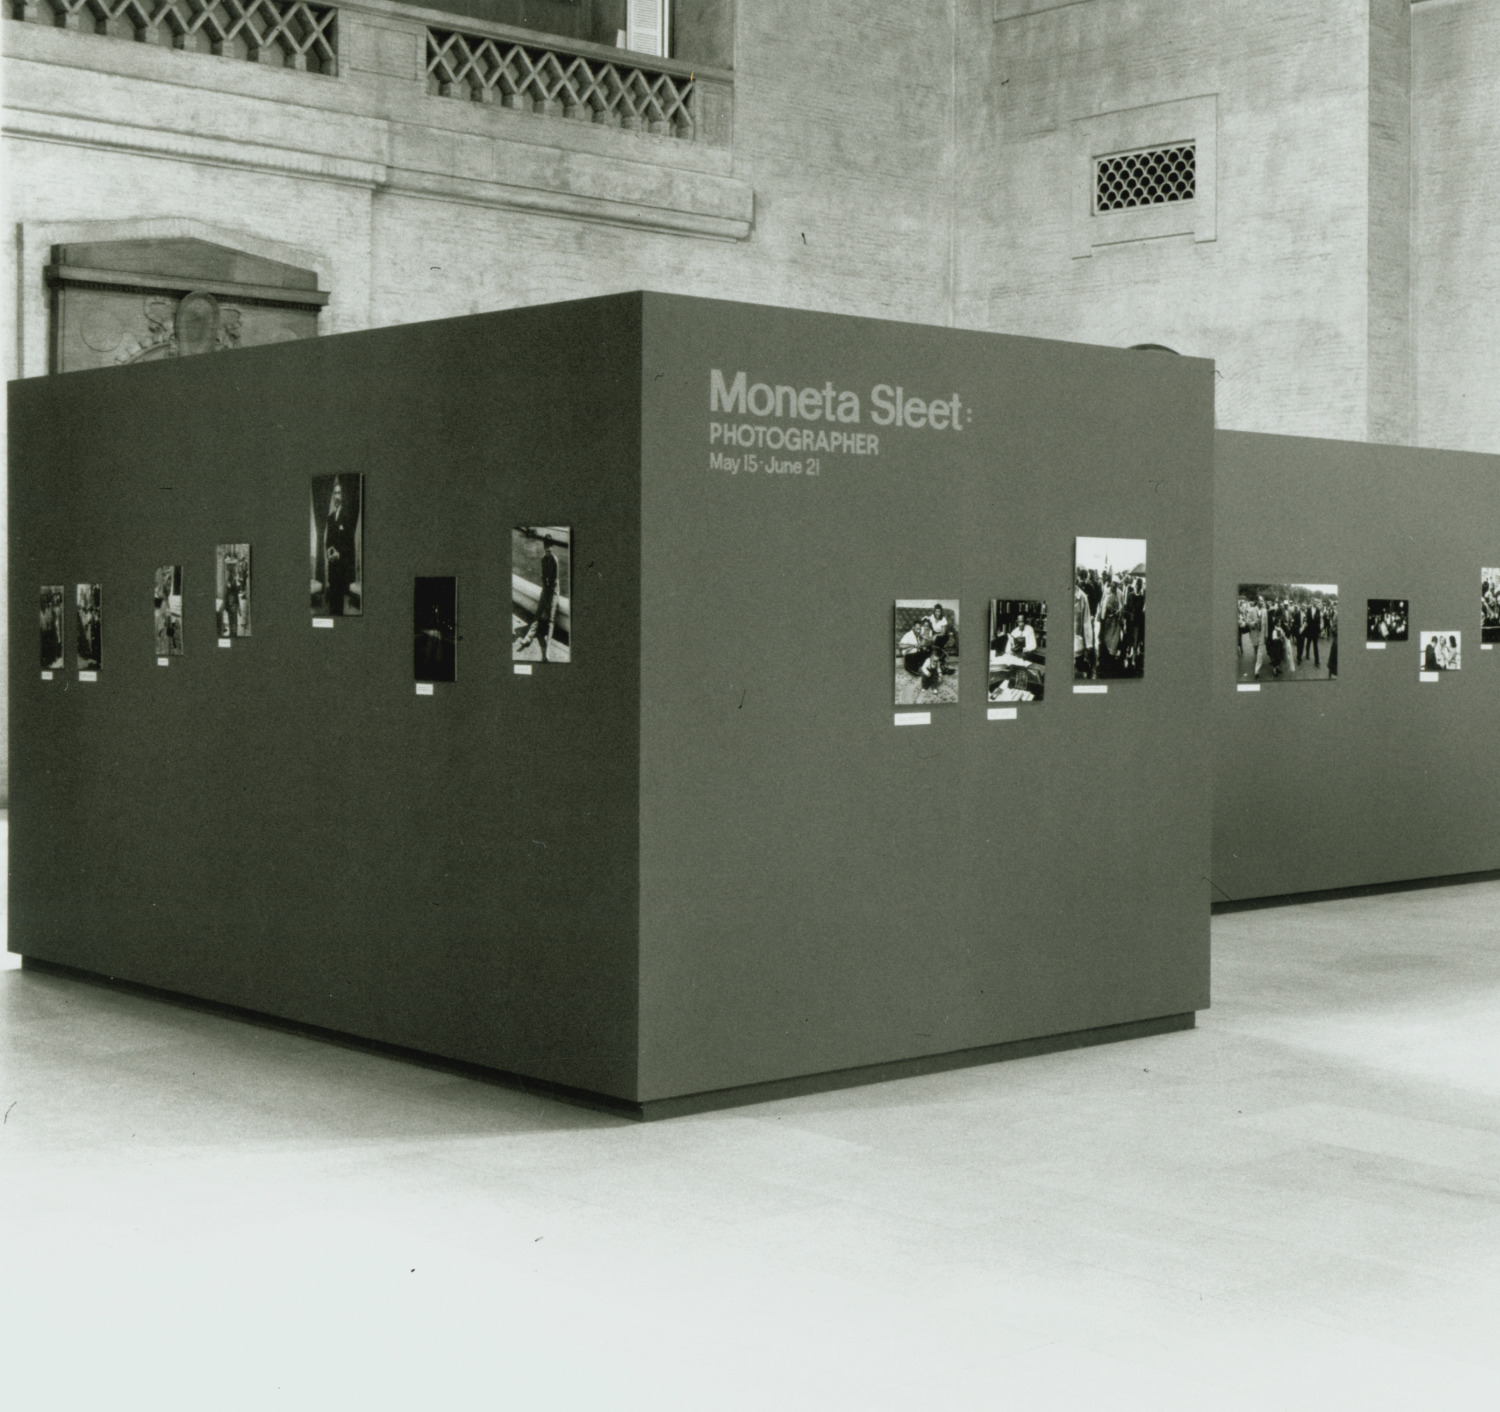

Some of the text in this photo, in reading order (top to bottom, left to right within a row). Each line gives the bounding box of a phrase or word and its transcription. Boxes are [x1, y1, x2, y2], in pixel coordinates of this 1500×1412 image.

[710, 368, 972, 431] Moneta Sleet:
[709, 422, 879, 455] PHOTOGRAPHER
[709, 452, 740, 475] May
[806, 458, 820, 476] 21
